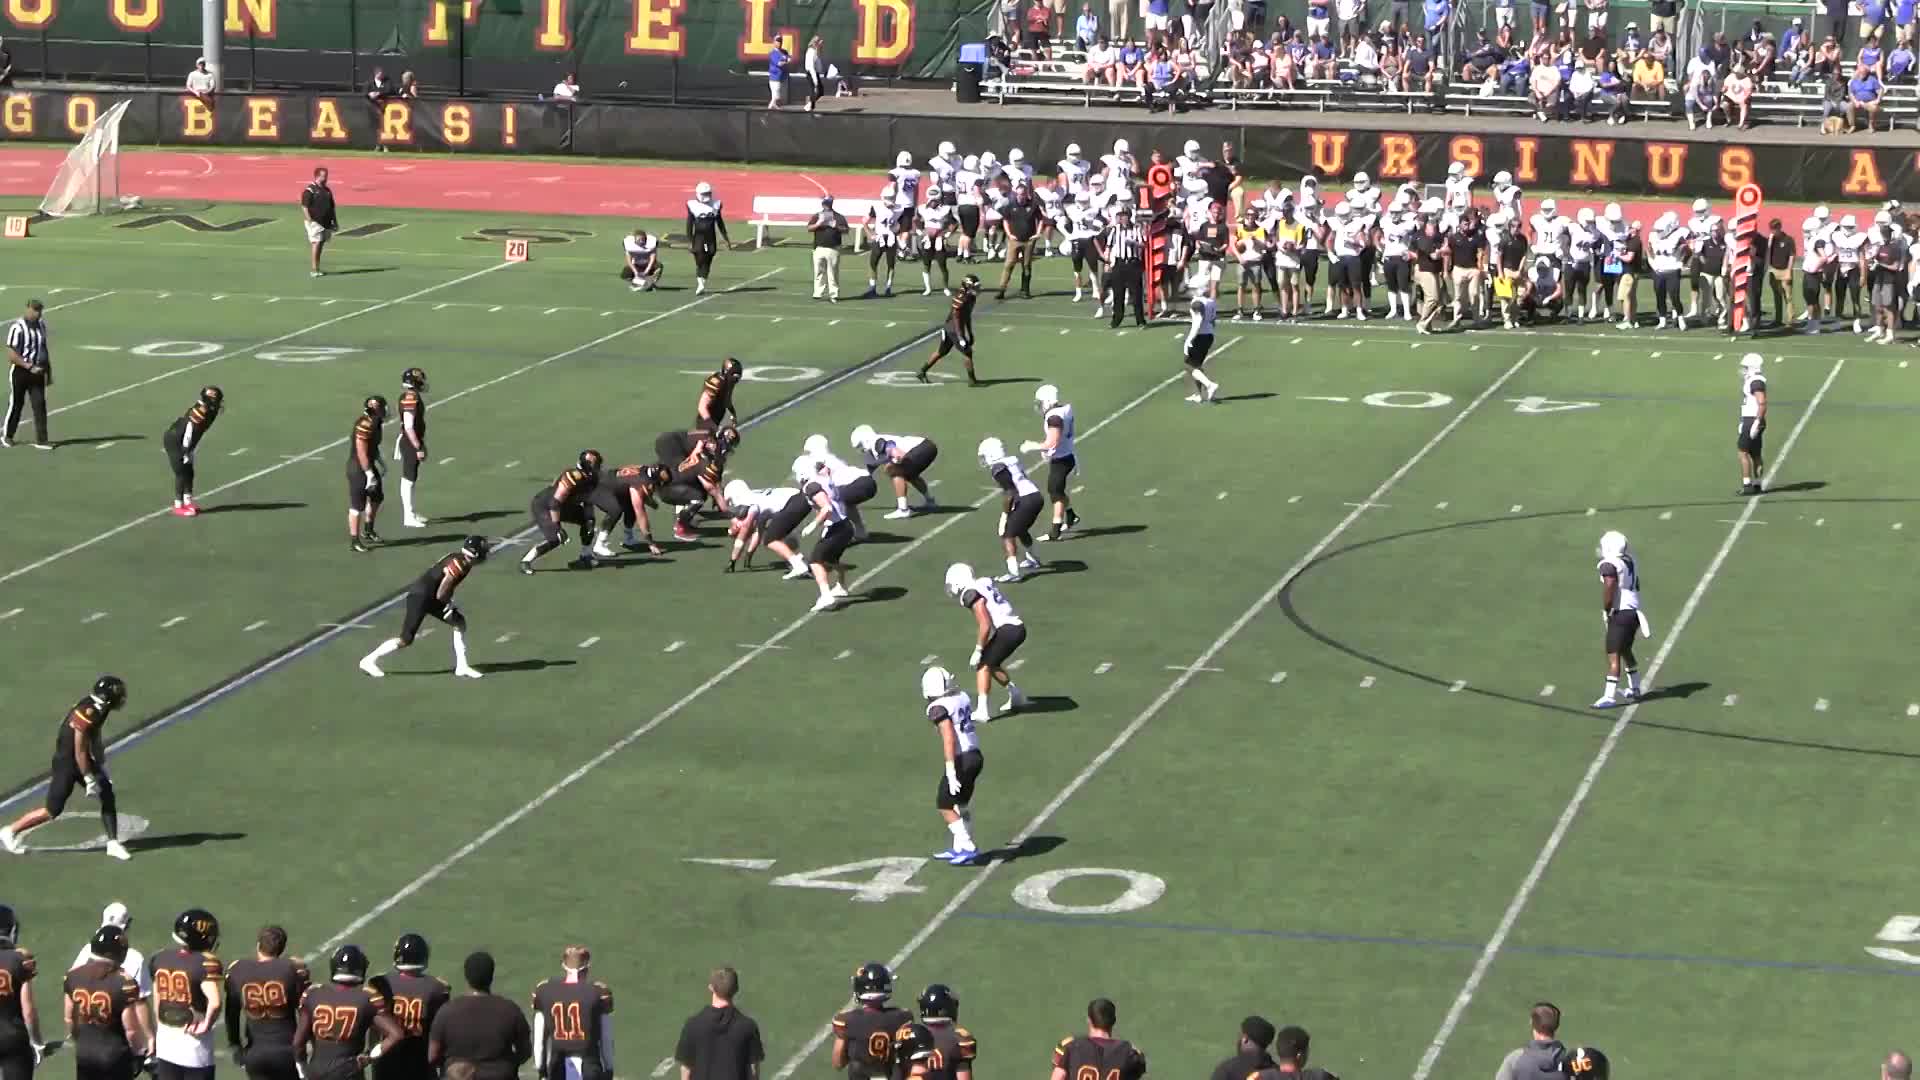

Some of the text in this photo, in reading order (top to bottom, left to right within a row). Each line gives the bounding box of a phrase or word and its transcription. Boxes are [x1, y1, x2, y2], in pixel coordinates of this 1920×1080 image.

[424, 0, 918, 63] FIELD
[3, 94, 519, 148] GO BEARS!
[1309, 131, 1755, 192] URSINUS
[508, 241, 525, 257] 20
[312, 1004, 357, 1041] 27
[551, 1001, 585, 1041] 11
